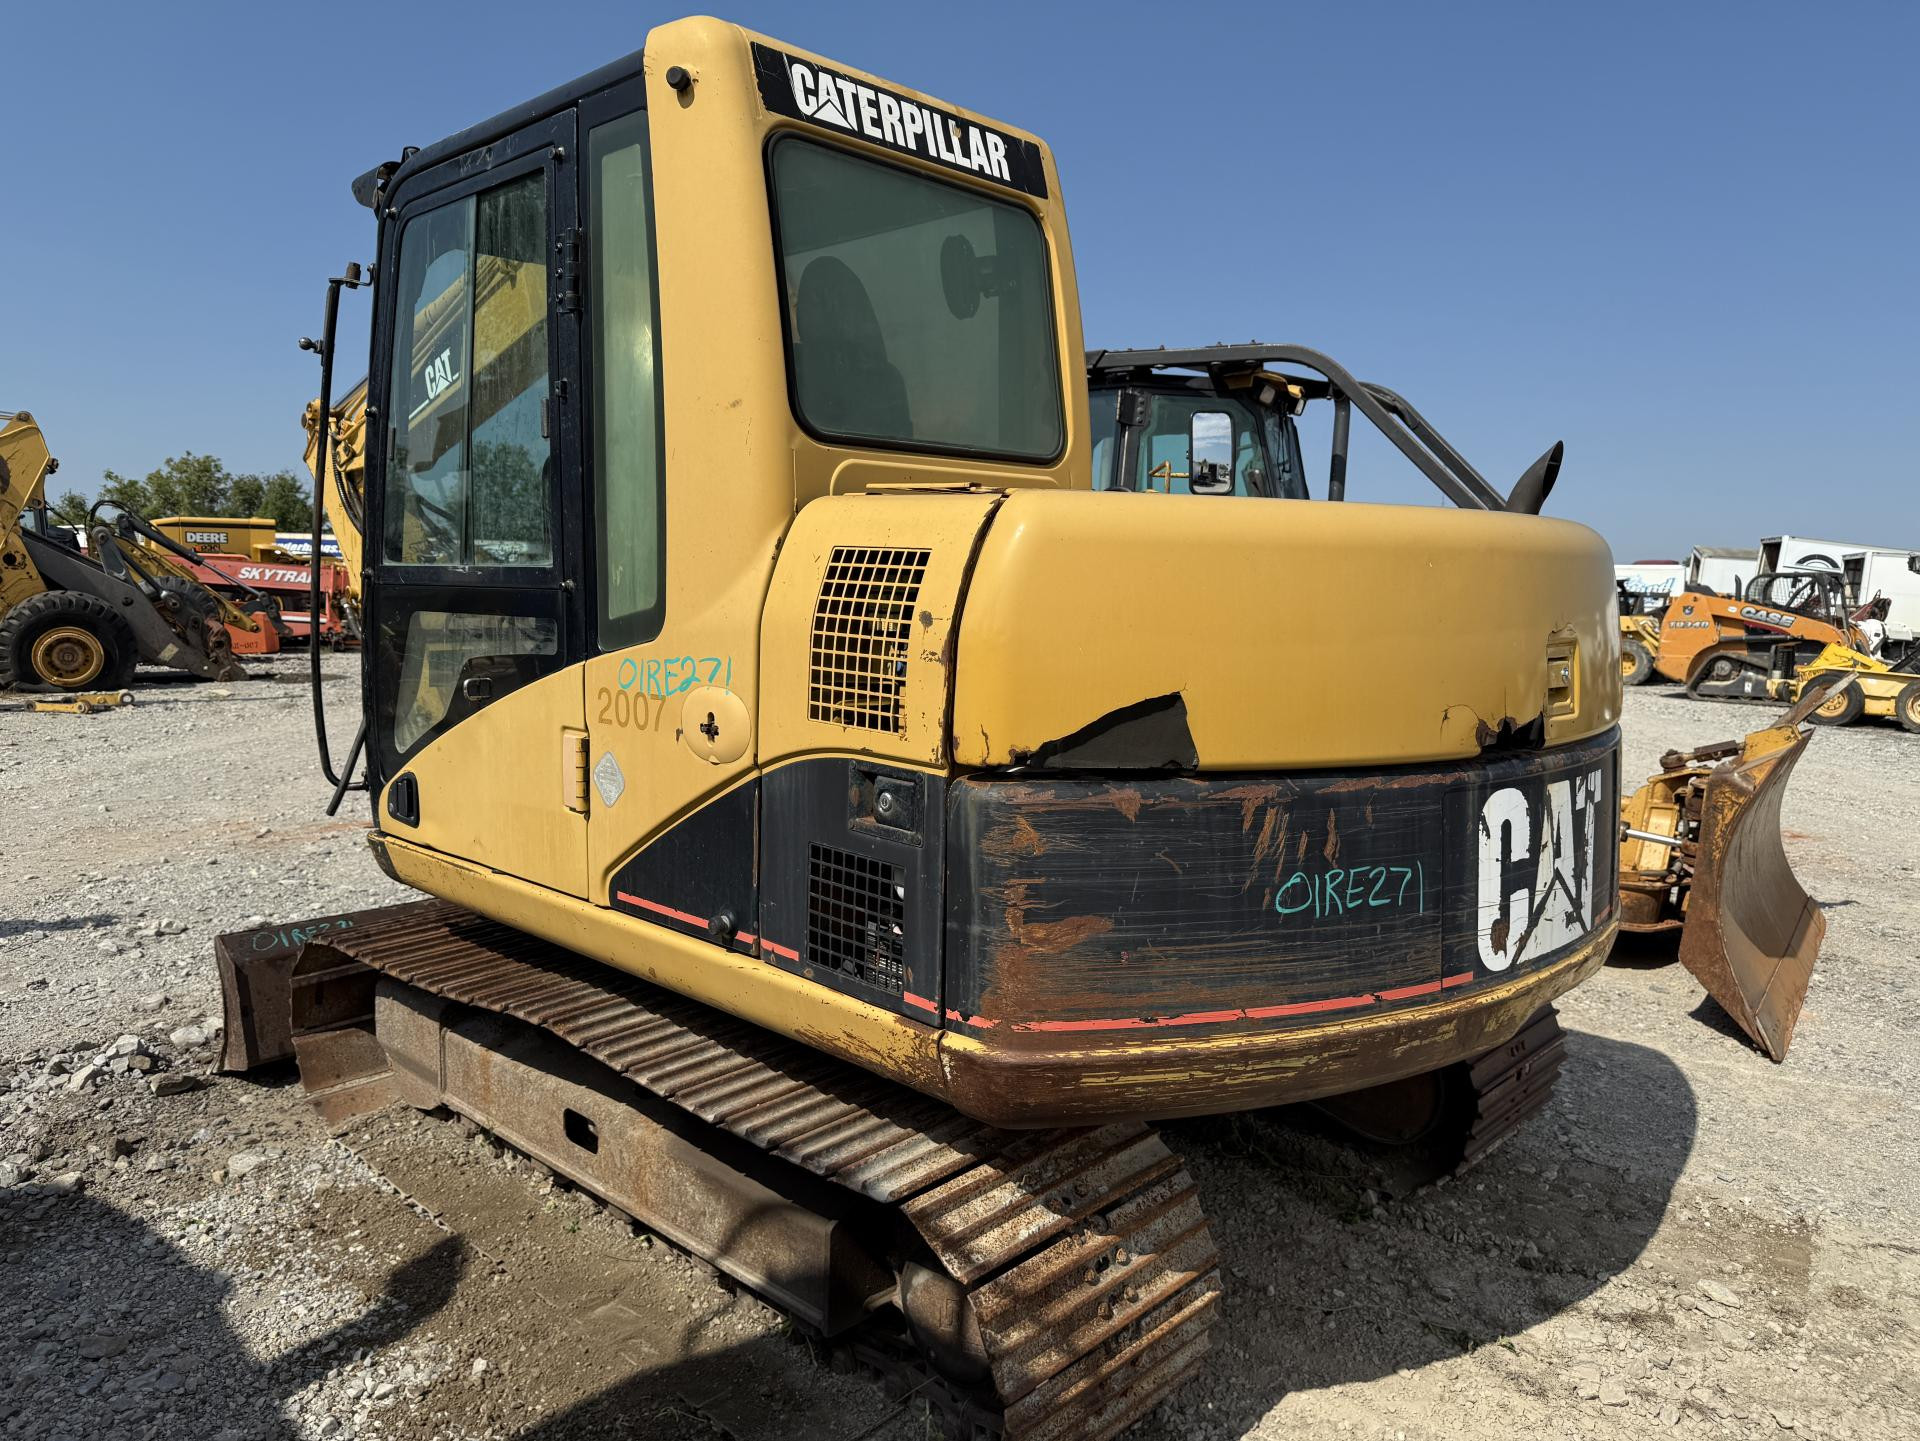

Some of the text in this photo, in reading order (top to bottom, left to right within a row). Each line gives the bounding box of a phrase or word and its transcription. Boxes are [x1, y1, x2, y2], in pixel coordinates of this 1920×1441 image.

[790, 63, 1010, 181] CATERPILLAR
[425, 347, 453, 399] CAT
[186, 532, 227, 543] DEERE
[1741, 606, 1795, 627] CASE
[597, 687, 666, 732] 2007
[1477, 769, 1602, 972] CAT
